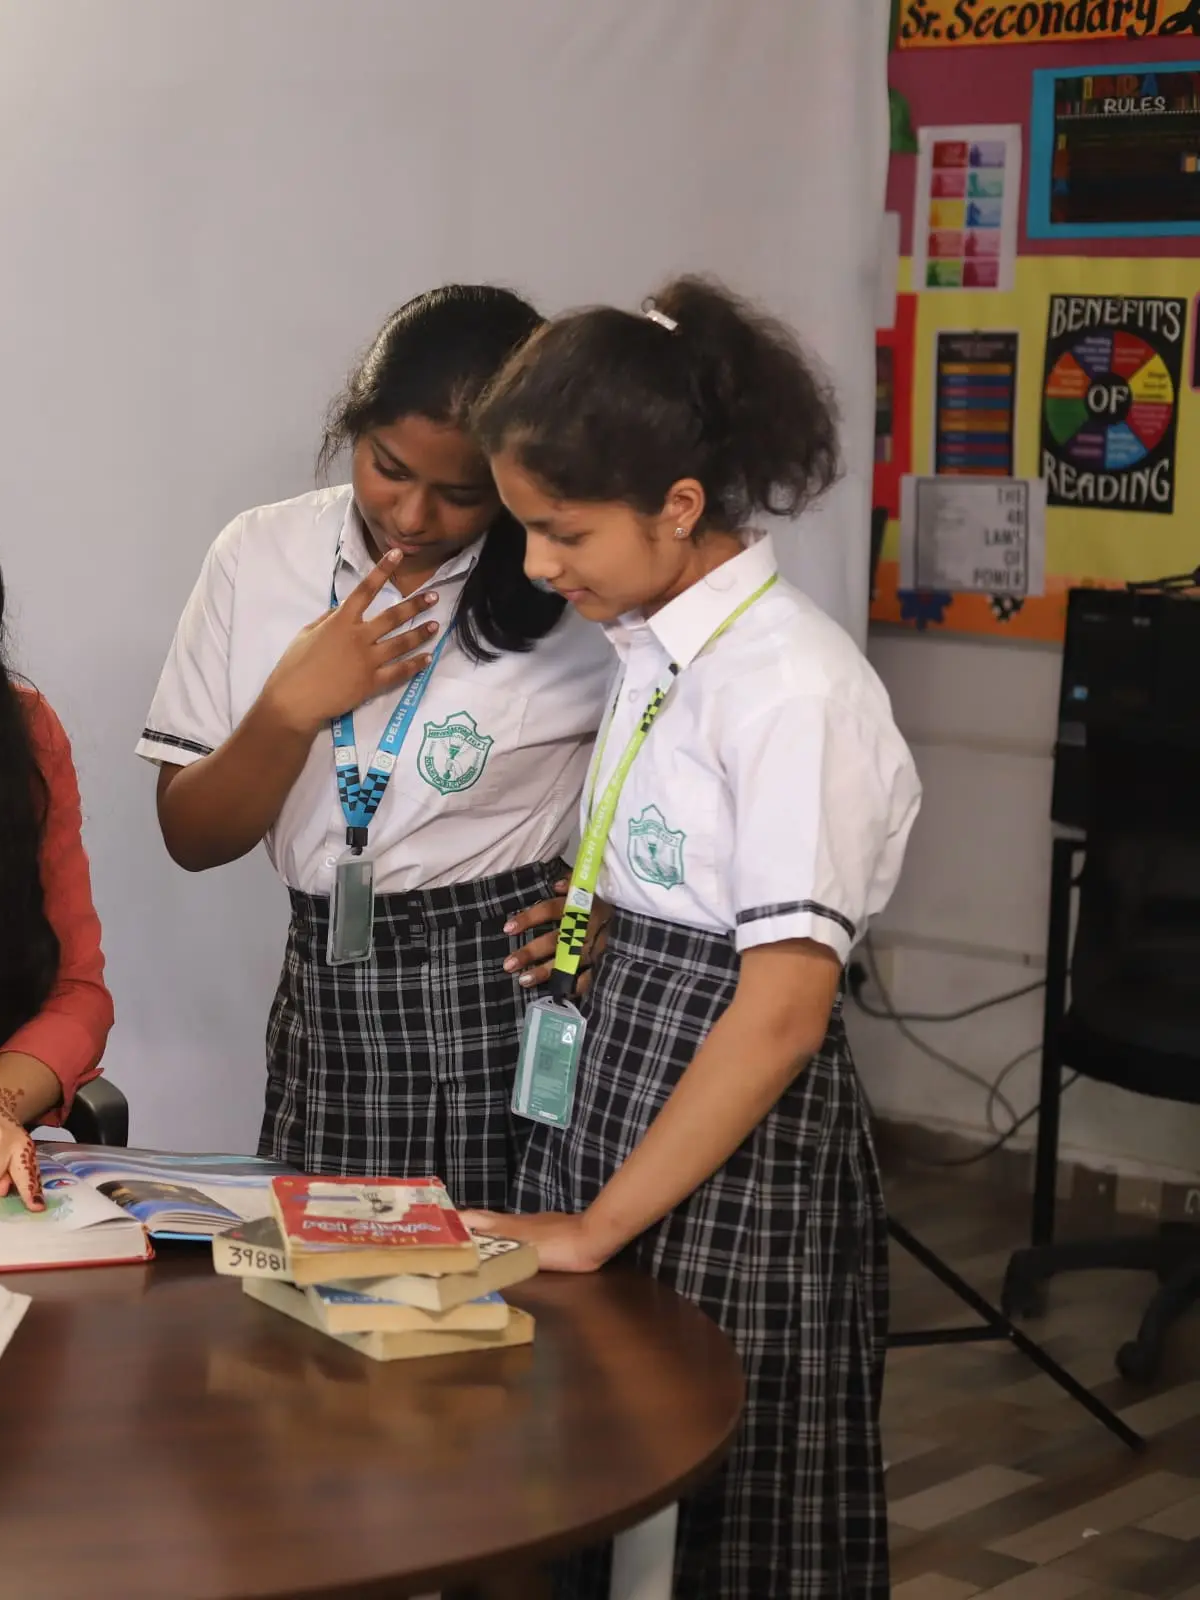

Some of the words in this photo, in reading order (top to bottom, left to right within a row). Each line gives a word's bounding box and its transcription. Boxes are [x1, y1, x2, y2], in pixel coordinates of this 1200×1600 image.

[946, 0, 1156, 41] Secondary
[1103, 95, 1166, 113] RULES
[1051, 298, 1181, 342] BENEFITS
[1087, 384, 1129, 414] OF
[1043, 449, 1170, 503] READING
[386, 708, 408, 744] DELHI
